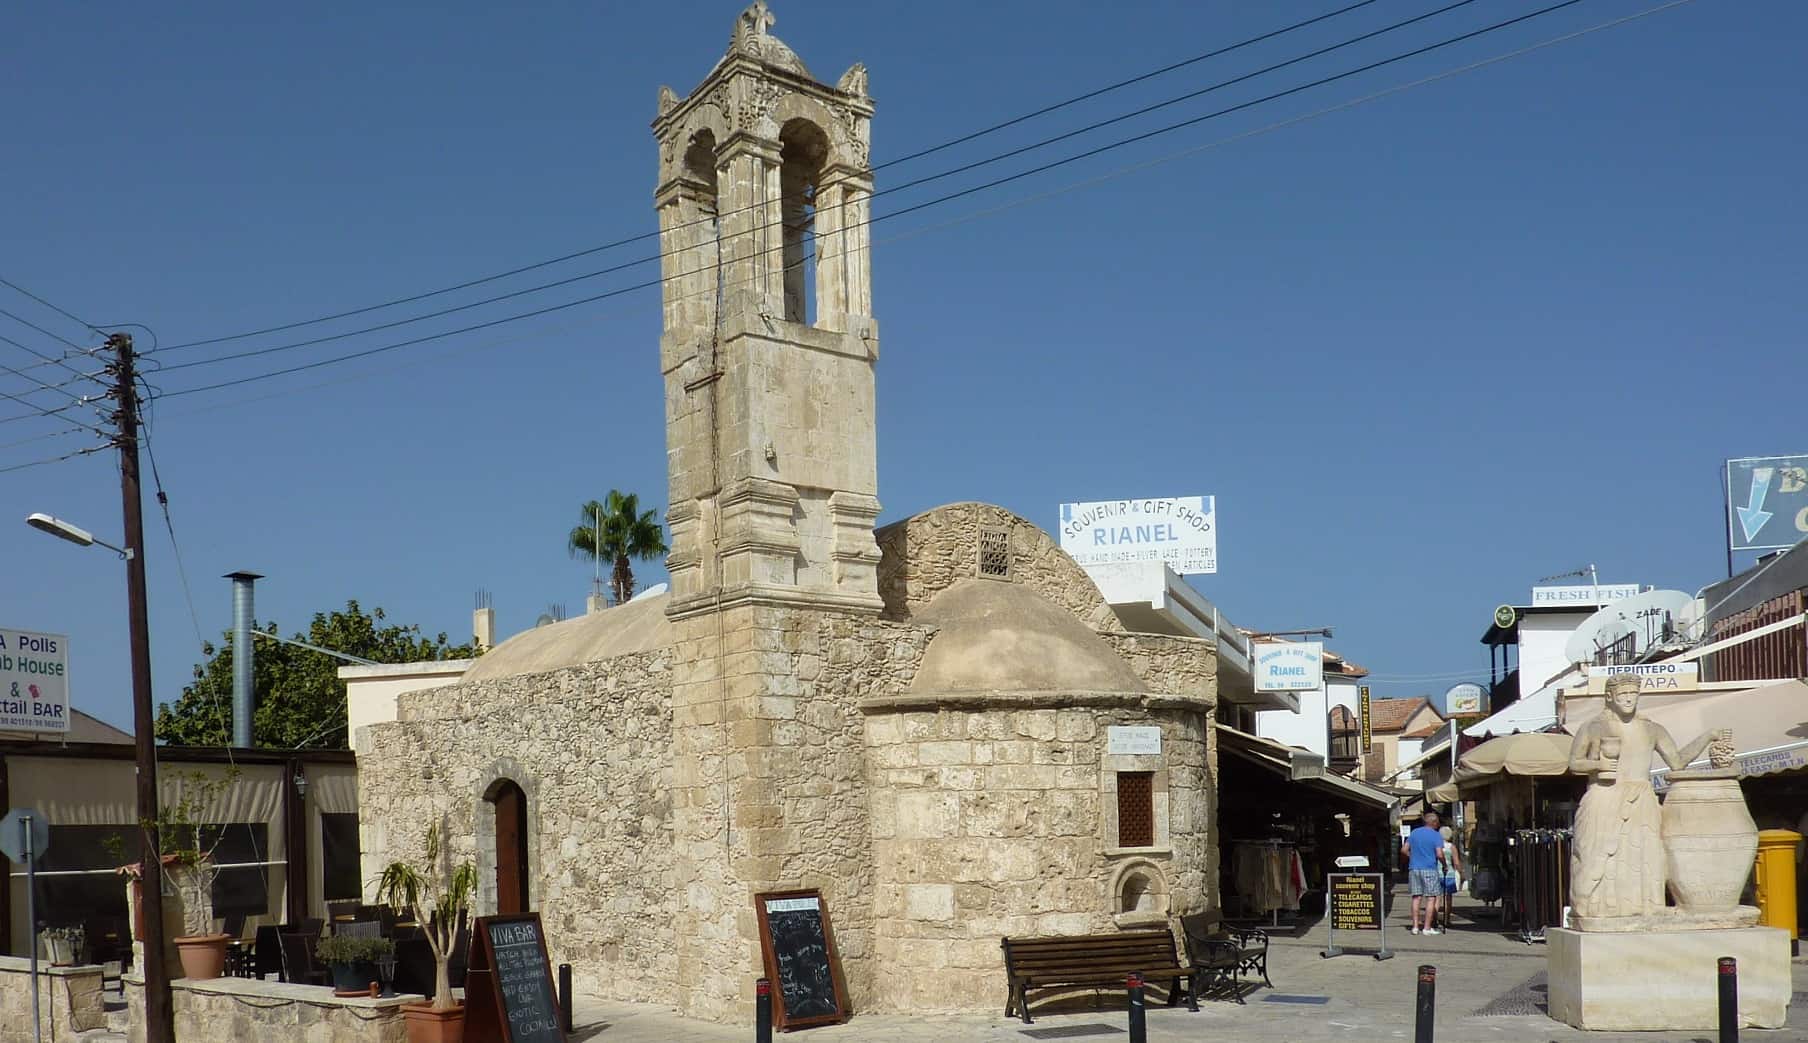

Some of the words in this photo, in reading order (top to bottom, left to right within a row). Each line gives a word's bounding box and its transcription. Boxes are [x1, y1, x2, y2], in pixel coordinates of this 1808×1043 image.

[1065, 502, 1127, 538] SOUVENIR
[1132, 502, 1139, 512] &
[1144, 500, 1172, 515] GIFT
[1177, 506, 1210, 533] SHOP
[1094, 523, 1178, 546] RIANEL
[1536, 590, 1590, 601] FRESH
[1597, 588, 1637, 600] FISH
[18, 656, 64, 676] House
[10, 681, 20, 698] &
[33, 702, 63, 718] BAR
[490, 926, 515, 945] VIVA
[514, 924, 536, 942] BAR
